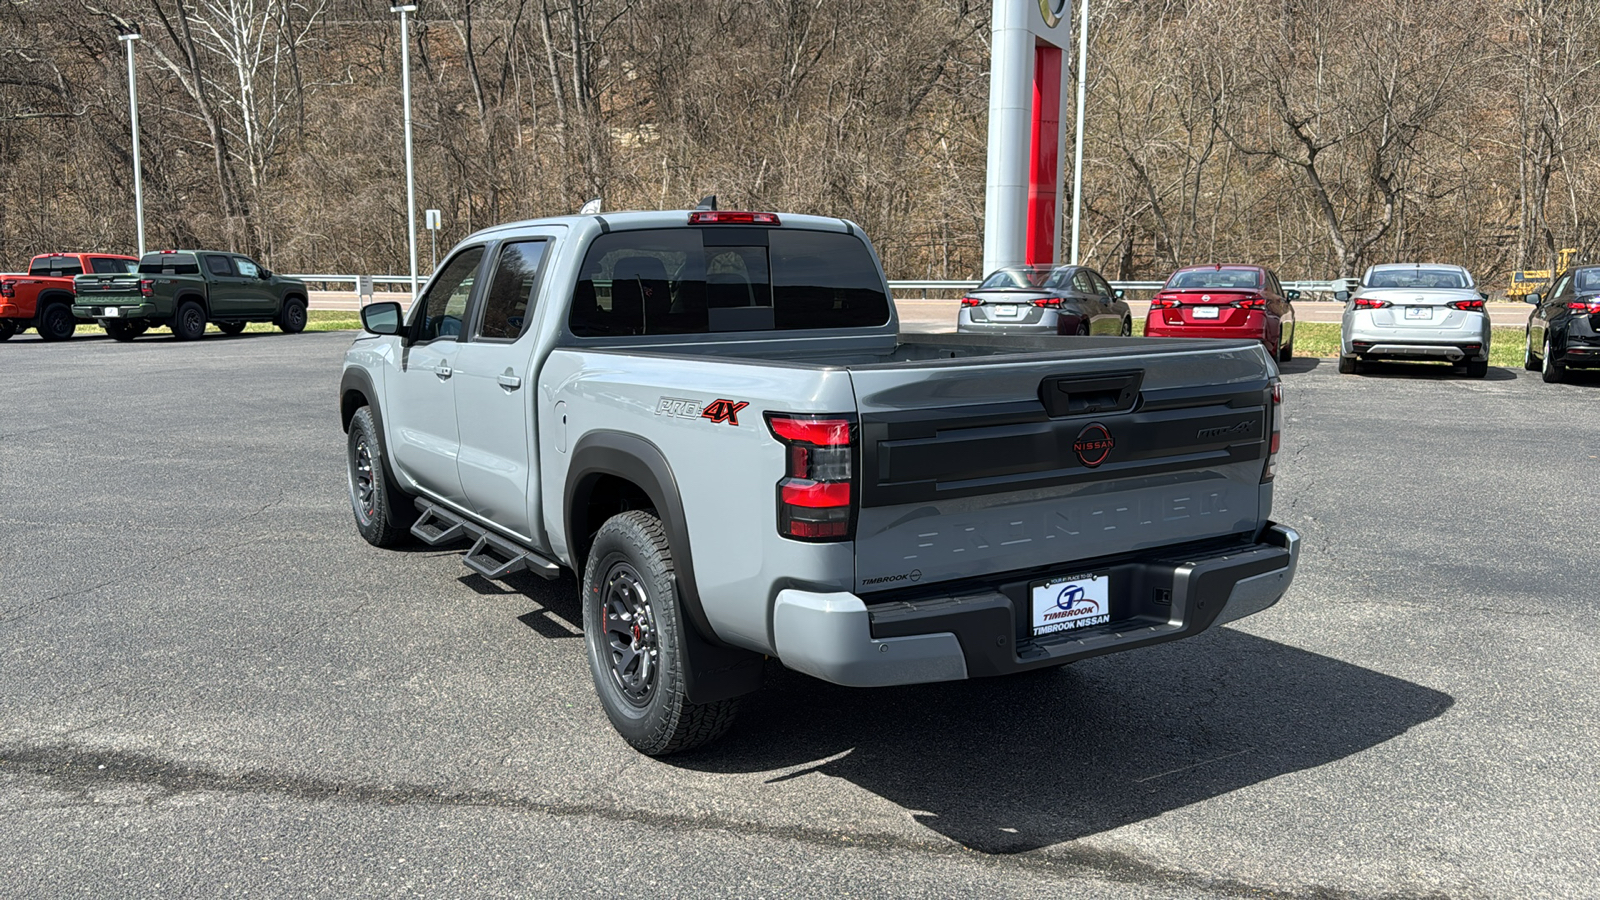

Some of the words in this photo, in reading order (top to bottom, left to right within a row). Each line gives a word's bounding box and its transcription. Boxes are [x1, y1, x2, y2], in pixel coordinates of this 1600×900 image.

[1073, 440, 1114, 451] NISSAN
[903, 488, 1228, 560] FRONTIER
[862, 573, 909, 586] TIMBROOK
[1043, 606, 1095, 622] TIMBROOK
[1033, 620, 1076, 636] TIMBROOK
[1076, 614, 1110, 628] NISSAN
